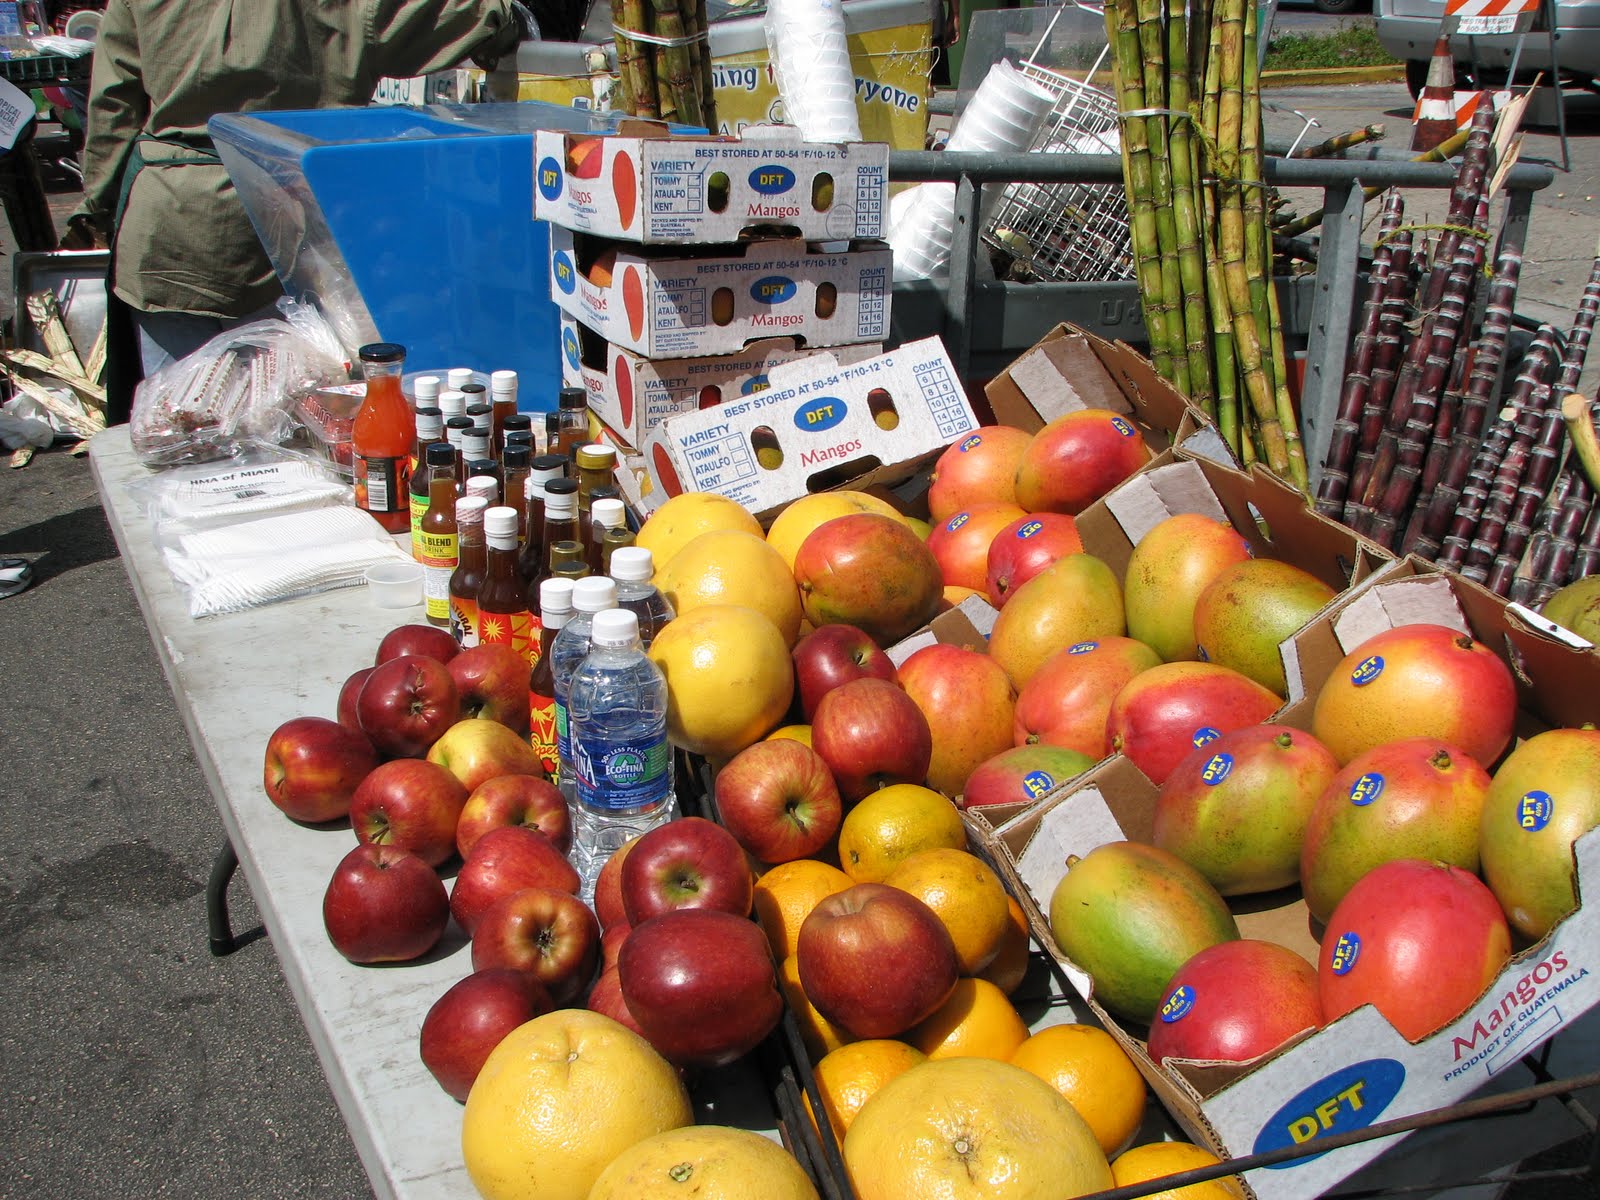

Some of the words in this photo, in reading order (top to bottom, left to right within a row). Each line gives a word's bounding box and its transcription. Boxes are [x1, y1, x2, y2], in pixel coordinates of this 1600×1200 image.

[855, 78, 918, 112] ryone
[695, 149, 719, 158] BEST
[722, 149, 759, 158] STORED
[761, 150, 773, 158] AT
[775, 150, 799, 158] 50-54
[651, 161, 696, 171] VARIETY
[543, 170, 558, 188] DFT
[654, 177, 681, 186] TOMMY
[760, 174, 785, 185] DFT
[861, 177, 866, 185] 6
[654, 189, 686, 199] ATAULFO
[654, 203, 673, 211] KENT
[747, 203, 800, 218] Mangos
[558, 262, 570, 282] DFT
[697, 265, 721, 274] BEST
[723, 263, 761, 272] STORED
[763, 262, 774, 270] AT
[776, 261, 800, 269] 50-54
[860, 268, 886, 276] COUNT
[654, 278, 698, 289] VARIETY
[761, 284, 785, 296] DFT
[657, 293, 684, 303] TOMMY
[657, 305, 689, 316] ATAULFO
[657, 318, 677, 328] KENT
[751, 313, 804, 328] Mangos
[861, 314, 869, 322] 14
[688, 365, 712, 374] BEST
[714, 362, 751, 372] STORED
[754, 360, 764, 368] AT
[912, 358, 944, 373] COUNT
[645, 378, 689, 389] VARIETY
[922, 376, 928, 384] 6
[648, 392, 674, 402] TOMMY
[724, 403, 751, 418] BEST
[753, 389, 796, 408] STORED
[798, 384, 810, 395] AT
[812, 376, 840, 391] 50-54
[928, 388, 934, 396] 8
[942, 384, 948, 392] 9
[931, 400, 942, 408] 10
[946, 395, 956, 404] 12
[648, 404, 679, 414] ATAULFO
[806, 405, 834, 424] DFT
[937, 412, 947, 421] 14
[952, 408, 961, 416] 16
[942, 426, 953, 434] 18
[956, 420, 968, 430] 20
[680, 423, 730, 447] VARIETY
[689, 444, 720, 462] TOMMY
[800, 438, 862, 468] Mangos
[695, 456, 731, 476] ATAULFO
[190, 477, 219, 485] HMA
[240, 467, 279, 477] MIAMI
[699, 474, 721, 489] KENT
[1023, 523, 1042, 538] DFT
[428, 538, 452, 546] BLEND
[1352, 656, 1376, 678] DFT
[611, 747, 626, 756] LESS
[606, 762, 644, 776] ECO-FINA
[1203, 754, 1223, 780] DFT
[1351, 775, 1372, 800] DFT
[1522, 796, 1536, 827] DFT
[1332, 936, 1348, 970] DFT
[1162, 986, 1186, 1015] DFT
[1451, 950, 1569, 1062] Mangos
[1443, 1039, 1501, 1081] PRODUCT
[1503, 1020, 1518, 1038] OF
[1517, 968, 1590, 1022] GUATEMALA
[1287, 1081, 1366, 1144] DFT
